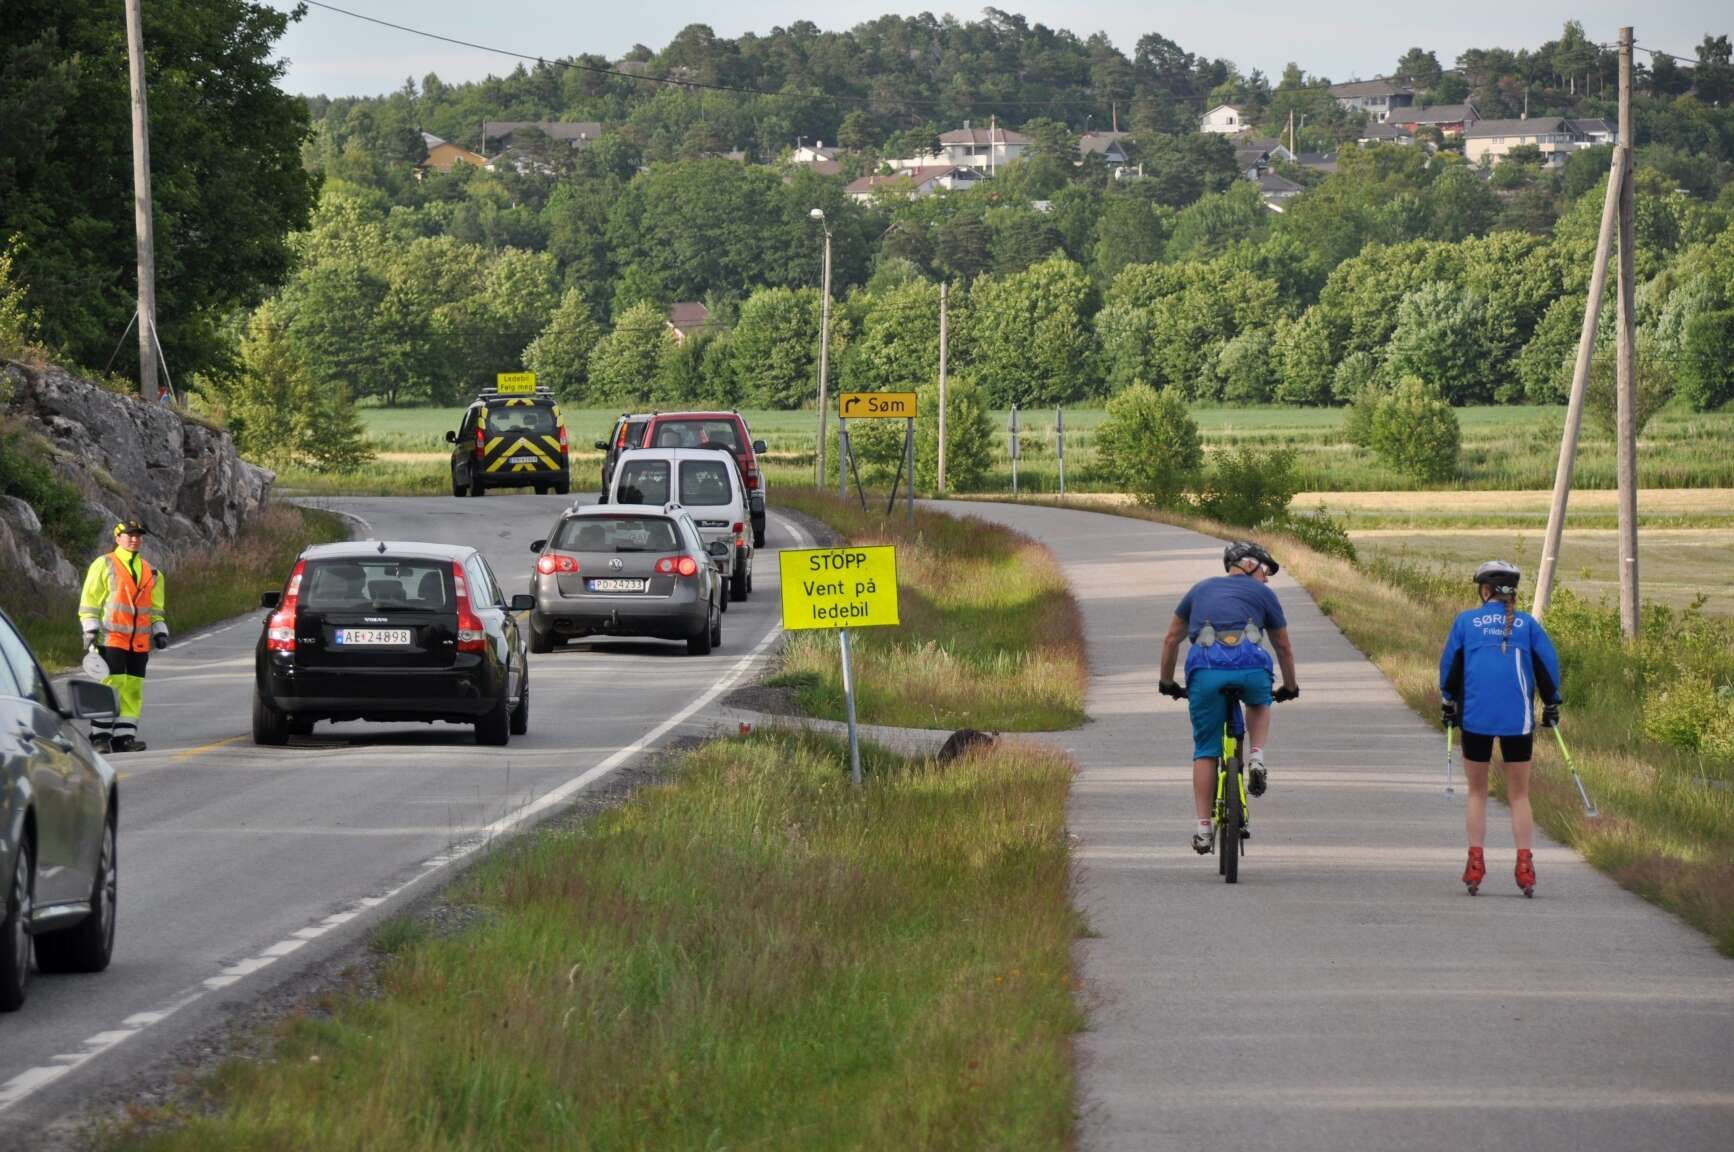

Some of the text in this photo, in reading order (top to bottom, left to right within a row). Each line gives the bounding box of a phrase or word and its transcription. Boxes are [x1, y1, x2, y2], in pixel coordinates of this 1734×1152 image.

[503, 375, 530, 383] Ledebil
[500, 384, 515, 392] Følg
[868, 397, 905, 412] Søm
[809, 553, 867, 571] STOPP
[803, 578, 876, 598] Vent på
[812, 601, 868, 619] ledebil
[345, 631, 408, 642] AE 24898
